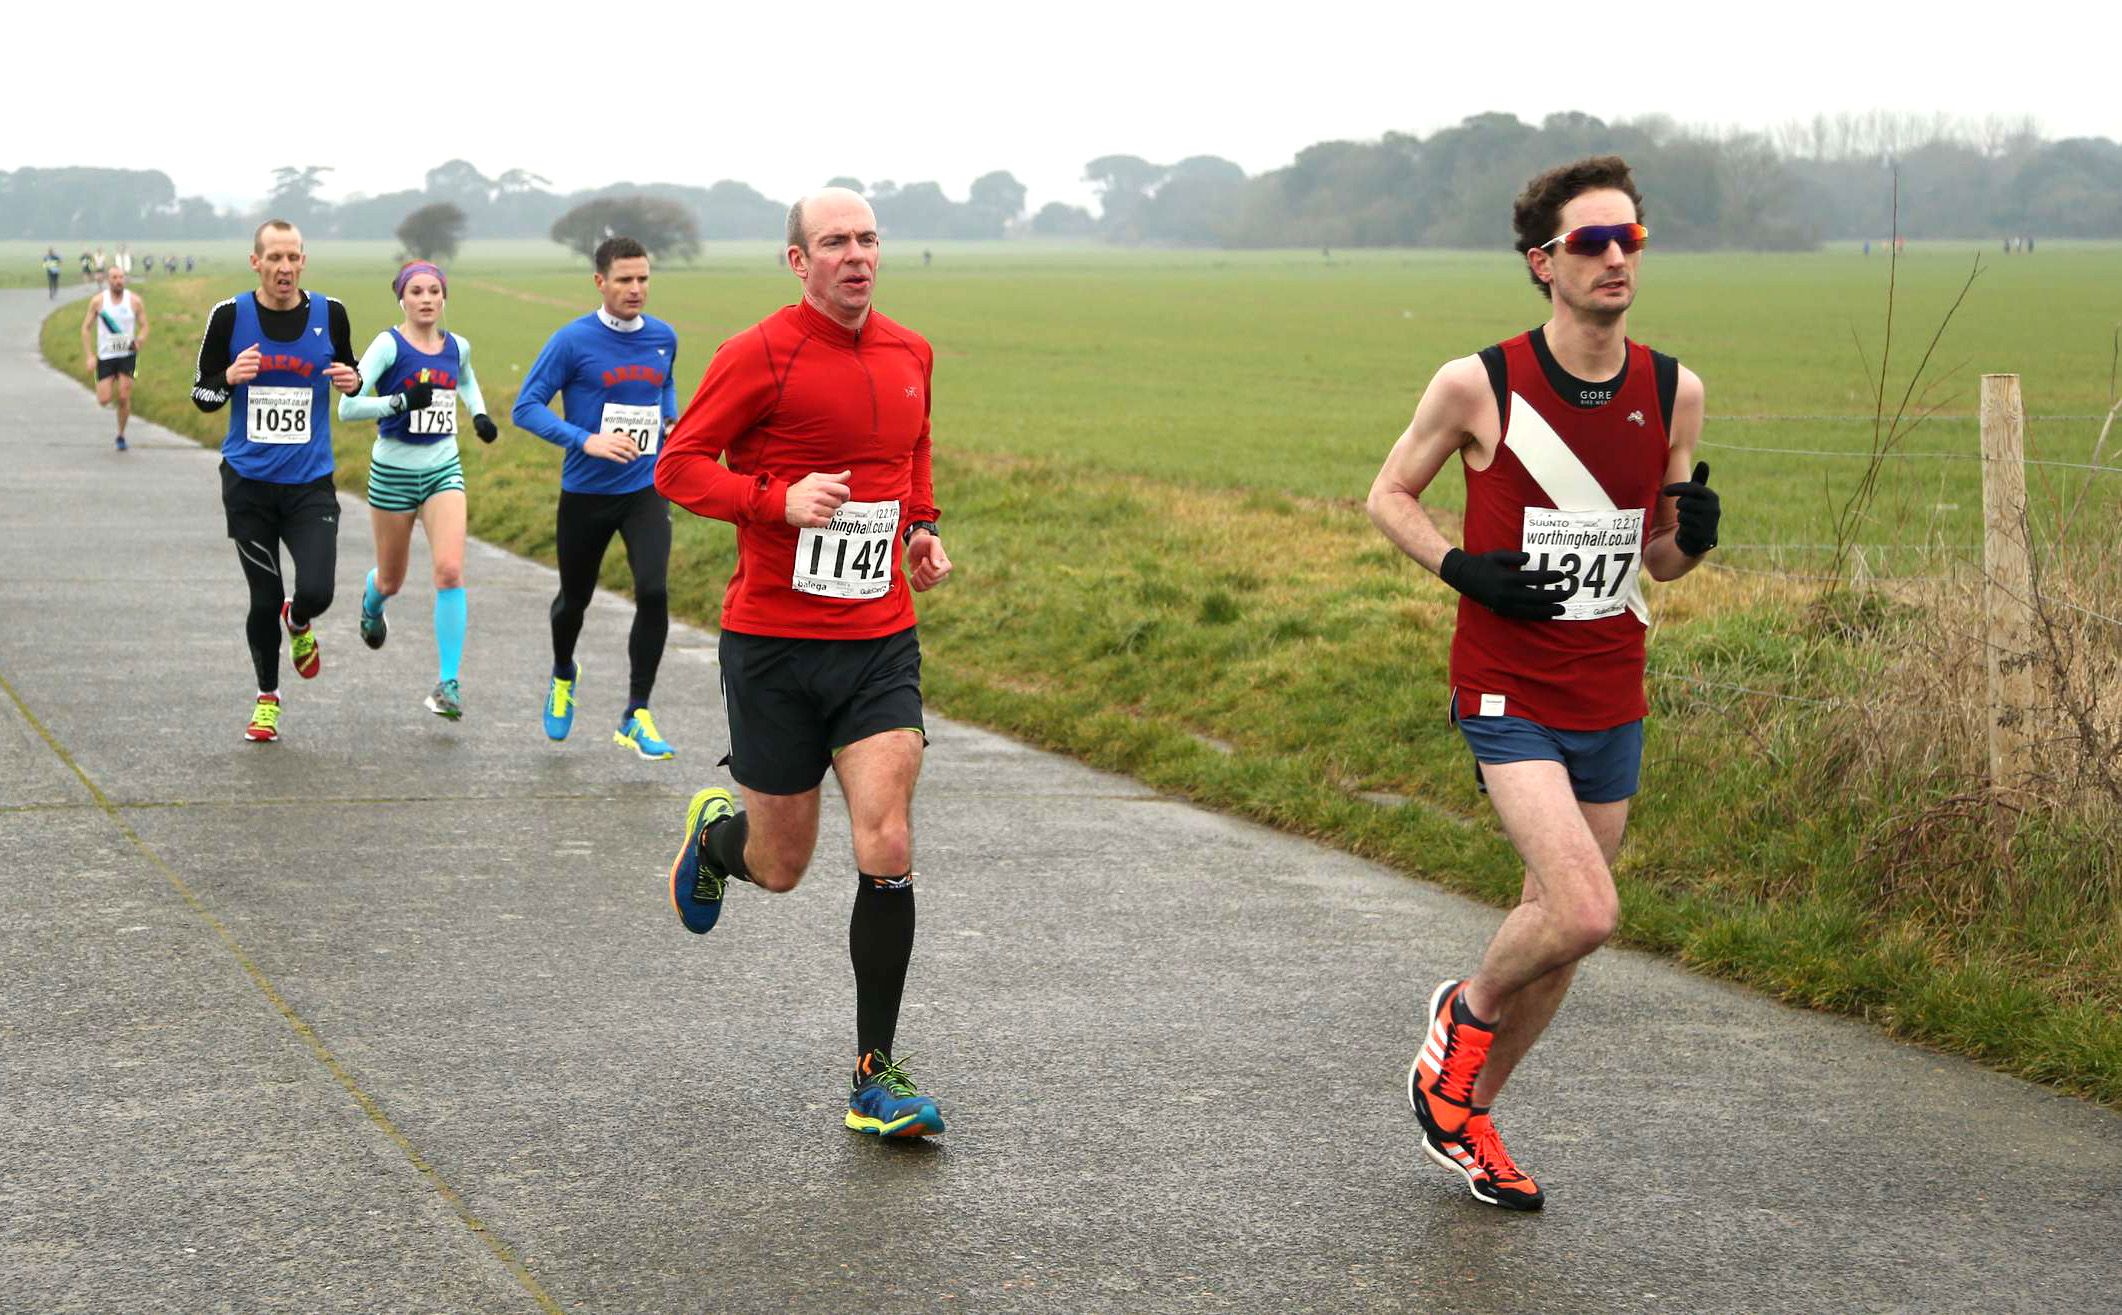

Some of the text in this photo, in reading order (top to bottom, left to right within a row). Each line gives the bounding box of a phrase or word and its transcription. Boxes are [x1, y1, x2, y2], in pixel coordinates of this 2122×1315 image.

[259, 354, 313, 377] RENA
[1580, 391, 1612, 399] GORE
[256, 408, 306, 432] 1058
[418, 411, 453, 432] 1795
[825, 517, 895, 536] hinghalf.co.uk
[1529, 519, 1570, 528] SUUNTO
[1613, 517, 1640, 530] 12.2.17
[1527, 529, 1638, 549] worthinghalf.co.uk
[809, 535, 888, 579] 1142
[797, 580, 827, 591] balega
